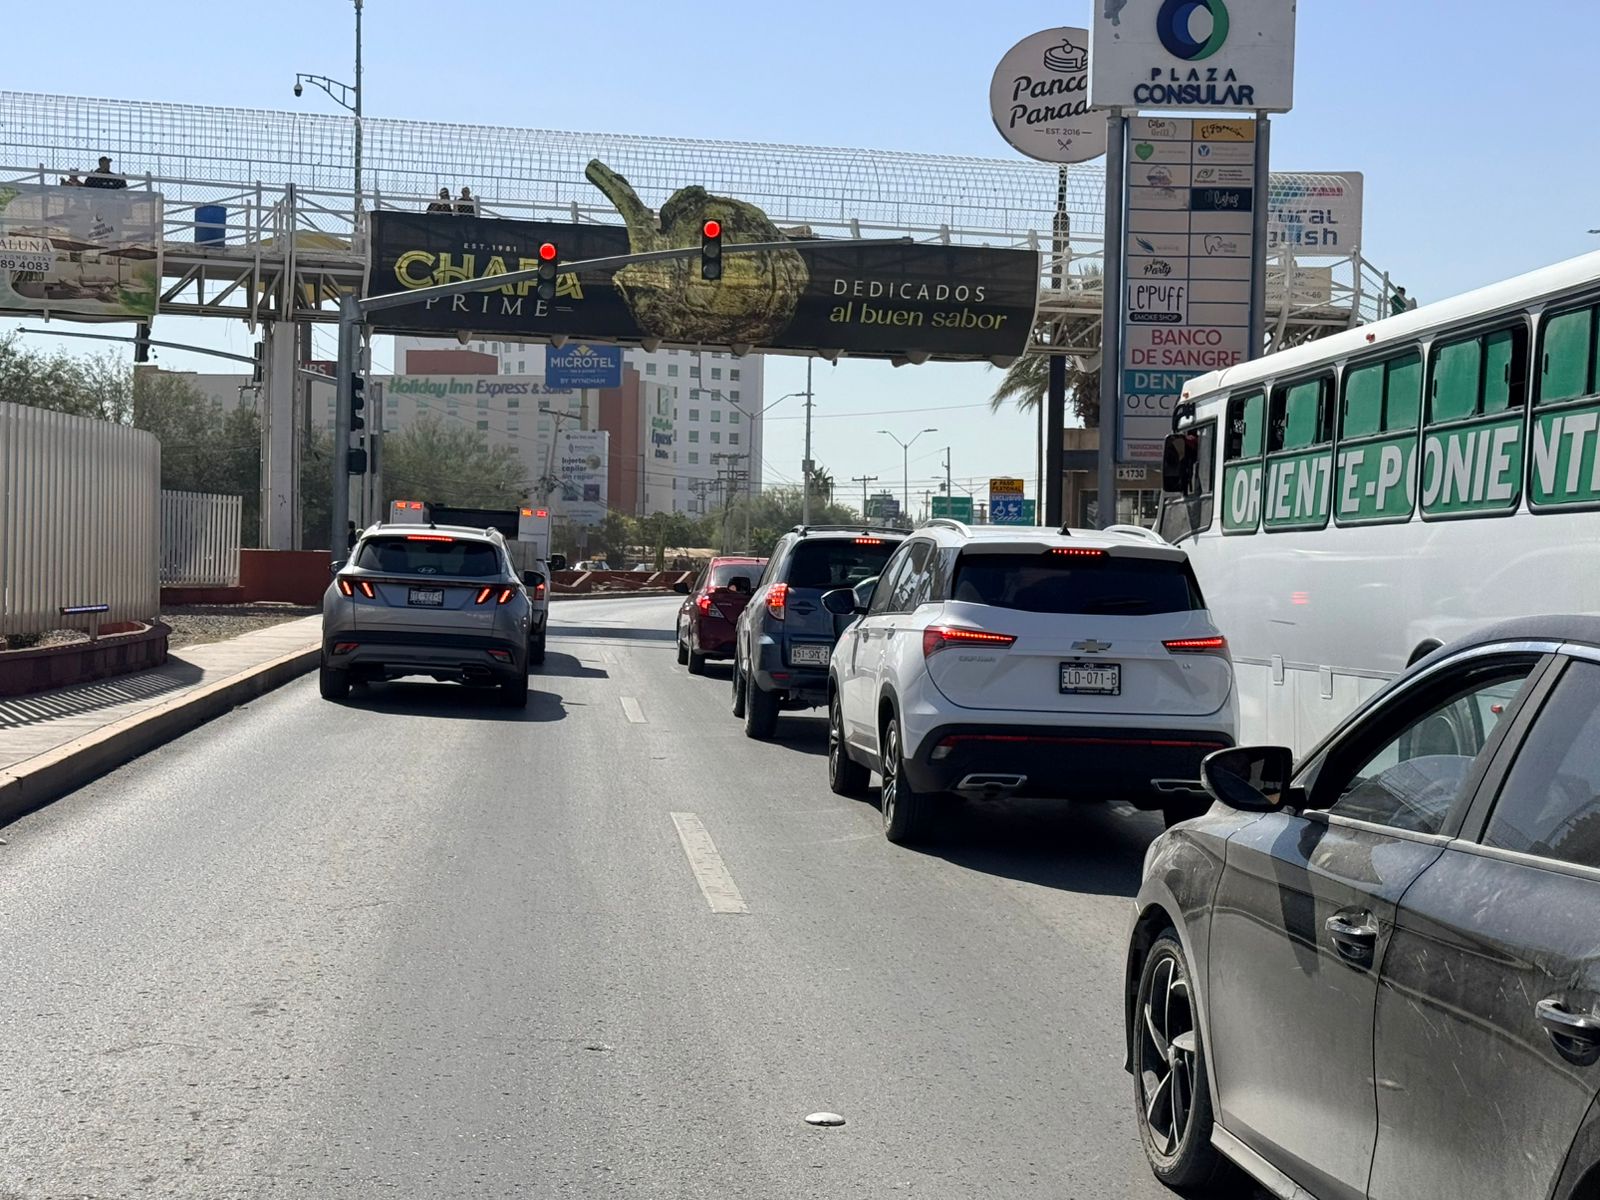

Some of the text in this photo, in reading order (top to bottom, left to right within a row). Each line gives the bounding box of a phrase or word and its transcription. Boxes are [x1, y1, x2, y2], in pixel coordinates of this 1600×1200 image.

[1151, 67, 1237, 82] PLAZA
[1012, 75, 1088, 101] Panca
[1133, 83, 1255, 105] CONSULAR
[1009, 98, 1099, 128] Parad
[18, 261, 50, 271] 4083
[833, 279, 986, 303] DEDICADOS
[424, 295, 549, 318] PRIME
[829, 301, 1008, 330] al buen sabor
[1151, 329, 1222, 346] BANCO
[551, 357, 615, 369] MICROTEL
[1131, 349, 1242, 367] DE SANGRE
[388, 376, 448, 399] Holiday
[450, 378, 473, 395] Inn
[476, 379, 529, 399] Express
[1134, 374, 1198, 389] DENT
[1126, 469, 1145, 479] 1730
[1062, 670, 1117, 686] ELD-071-B
